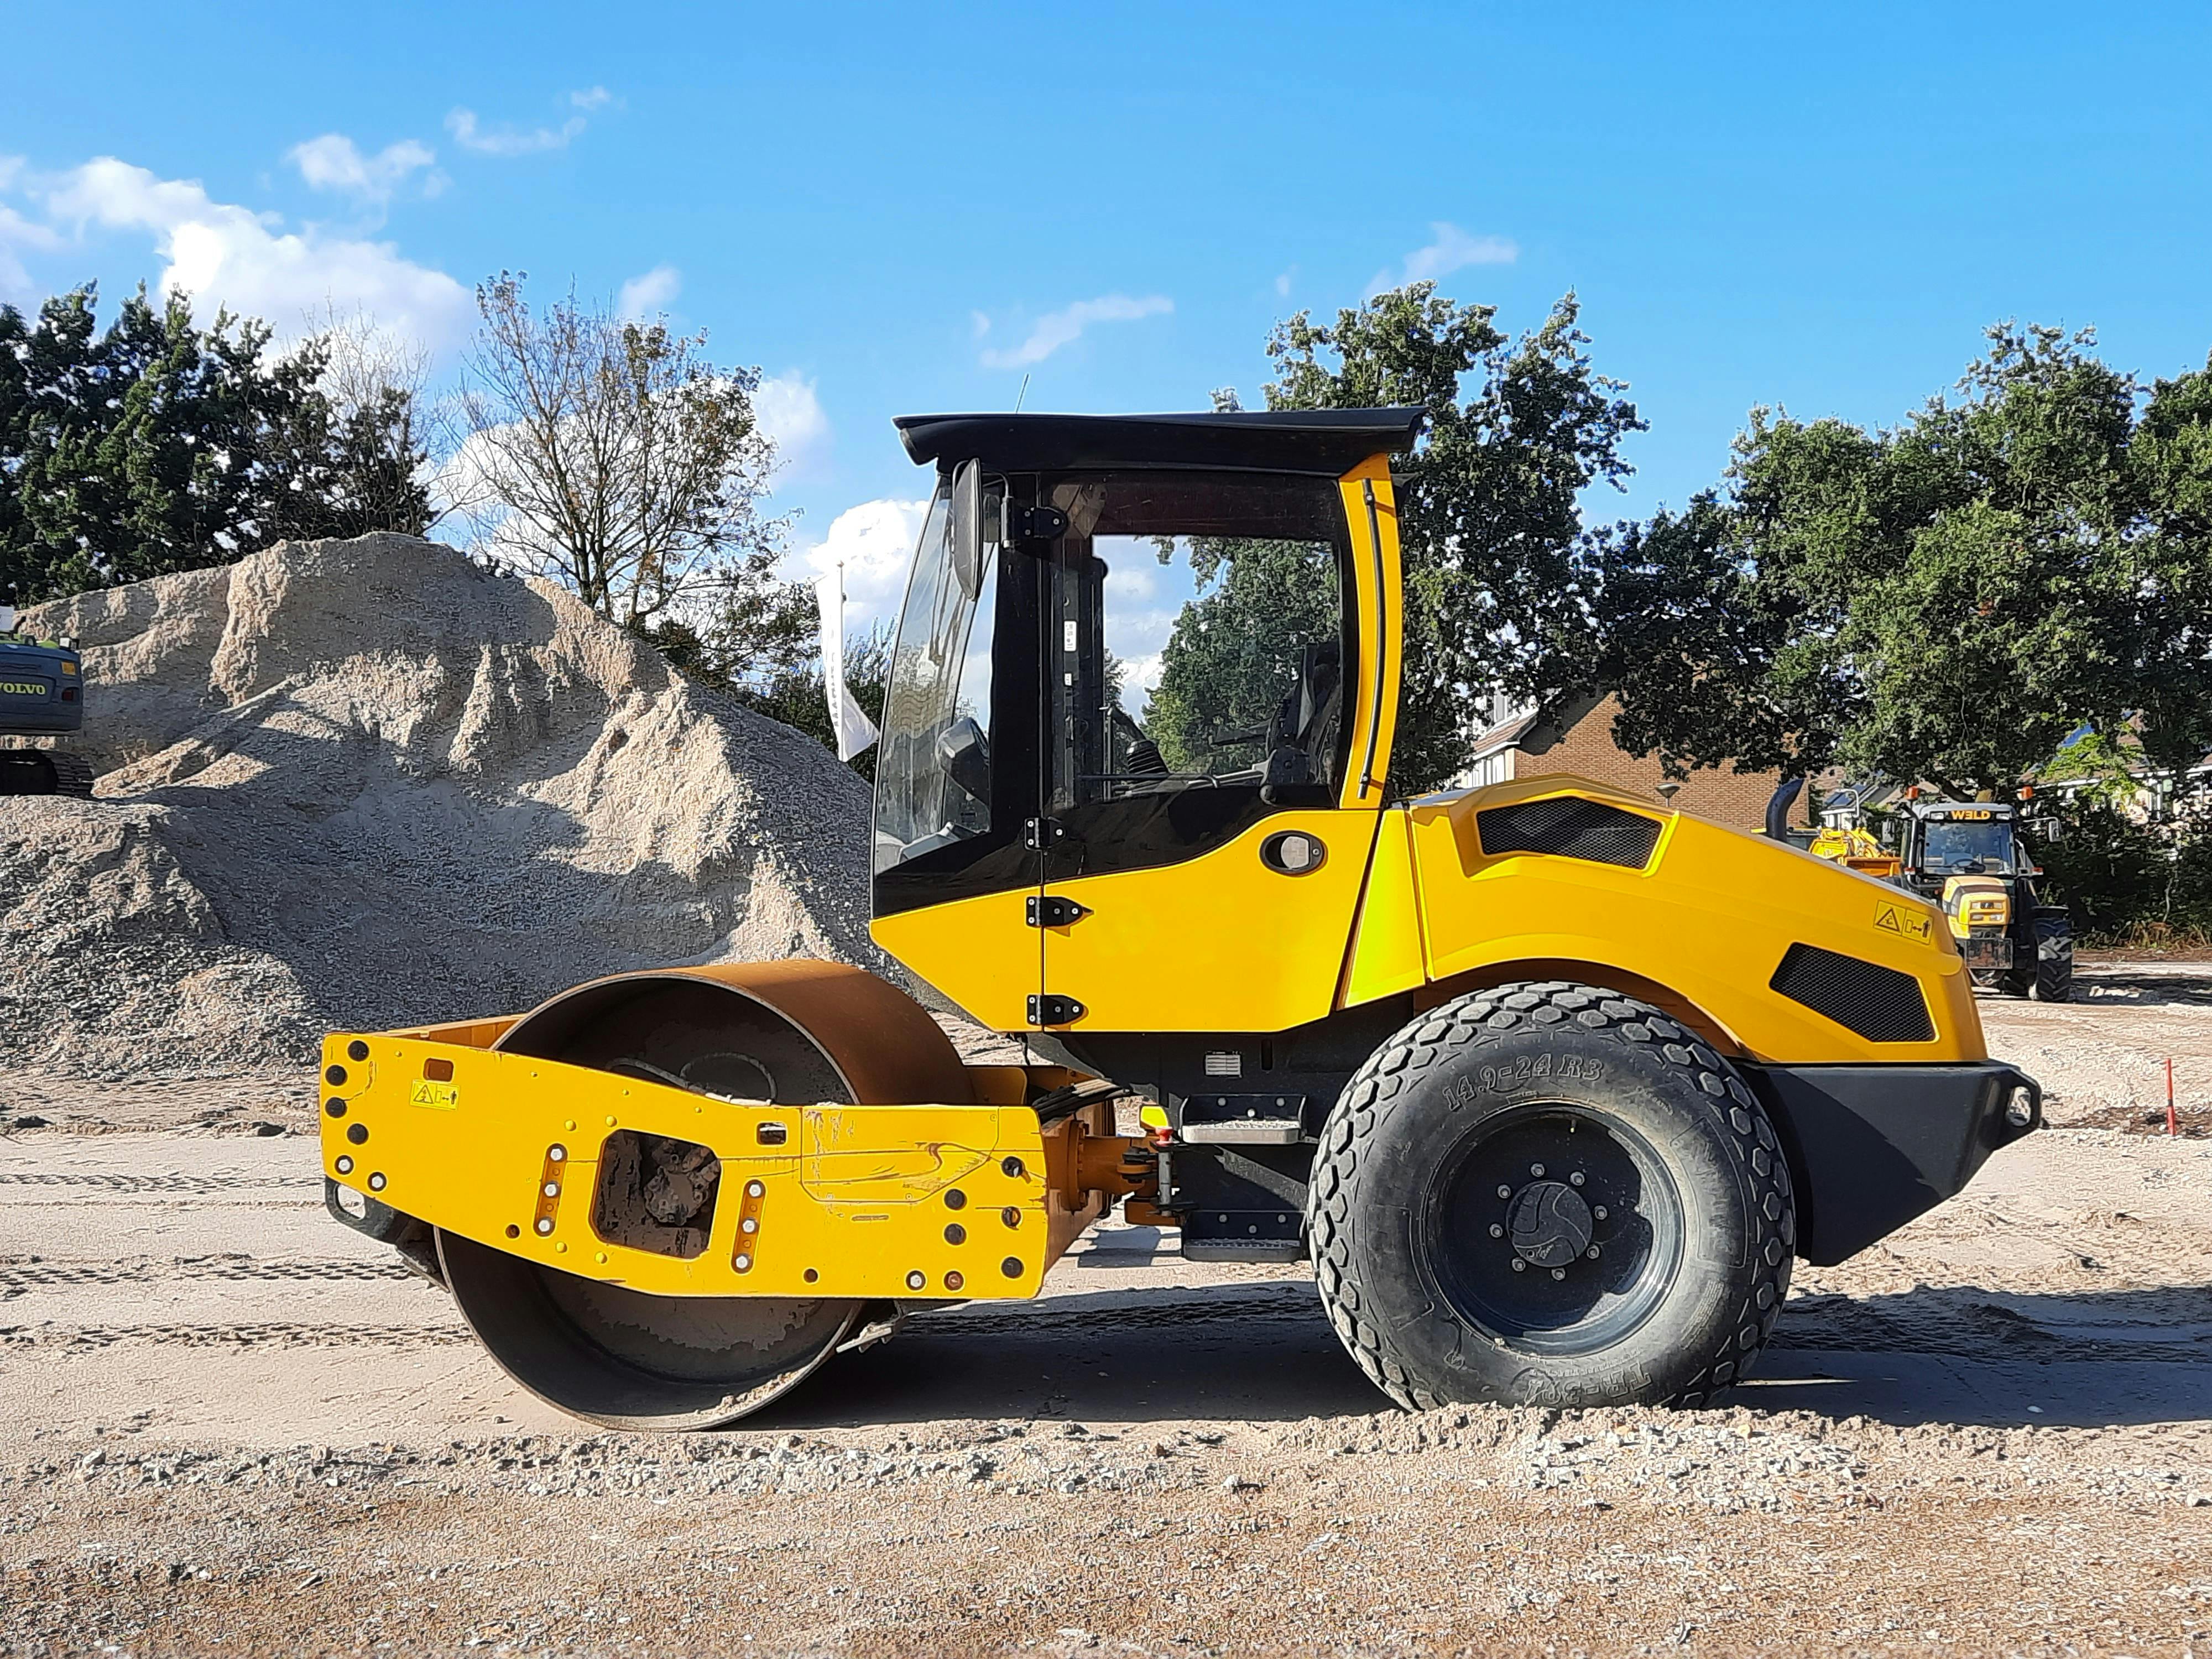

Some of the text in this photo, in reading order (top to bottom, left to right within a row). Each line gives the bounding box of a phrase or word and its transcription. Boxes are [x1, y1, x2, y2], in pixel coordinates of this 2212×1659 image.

[0, 682, 46, 695] OLVO
[1442, 1053, 1604, 1112] 14.9-24 R3
